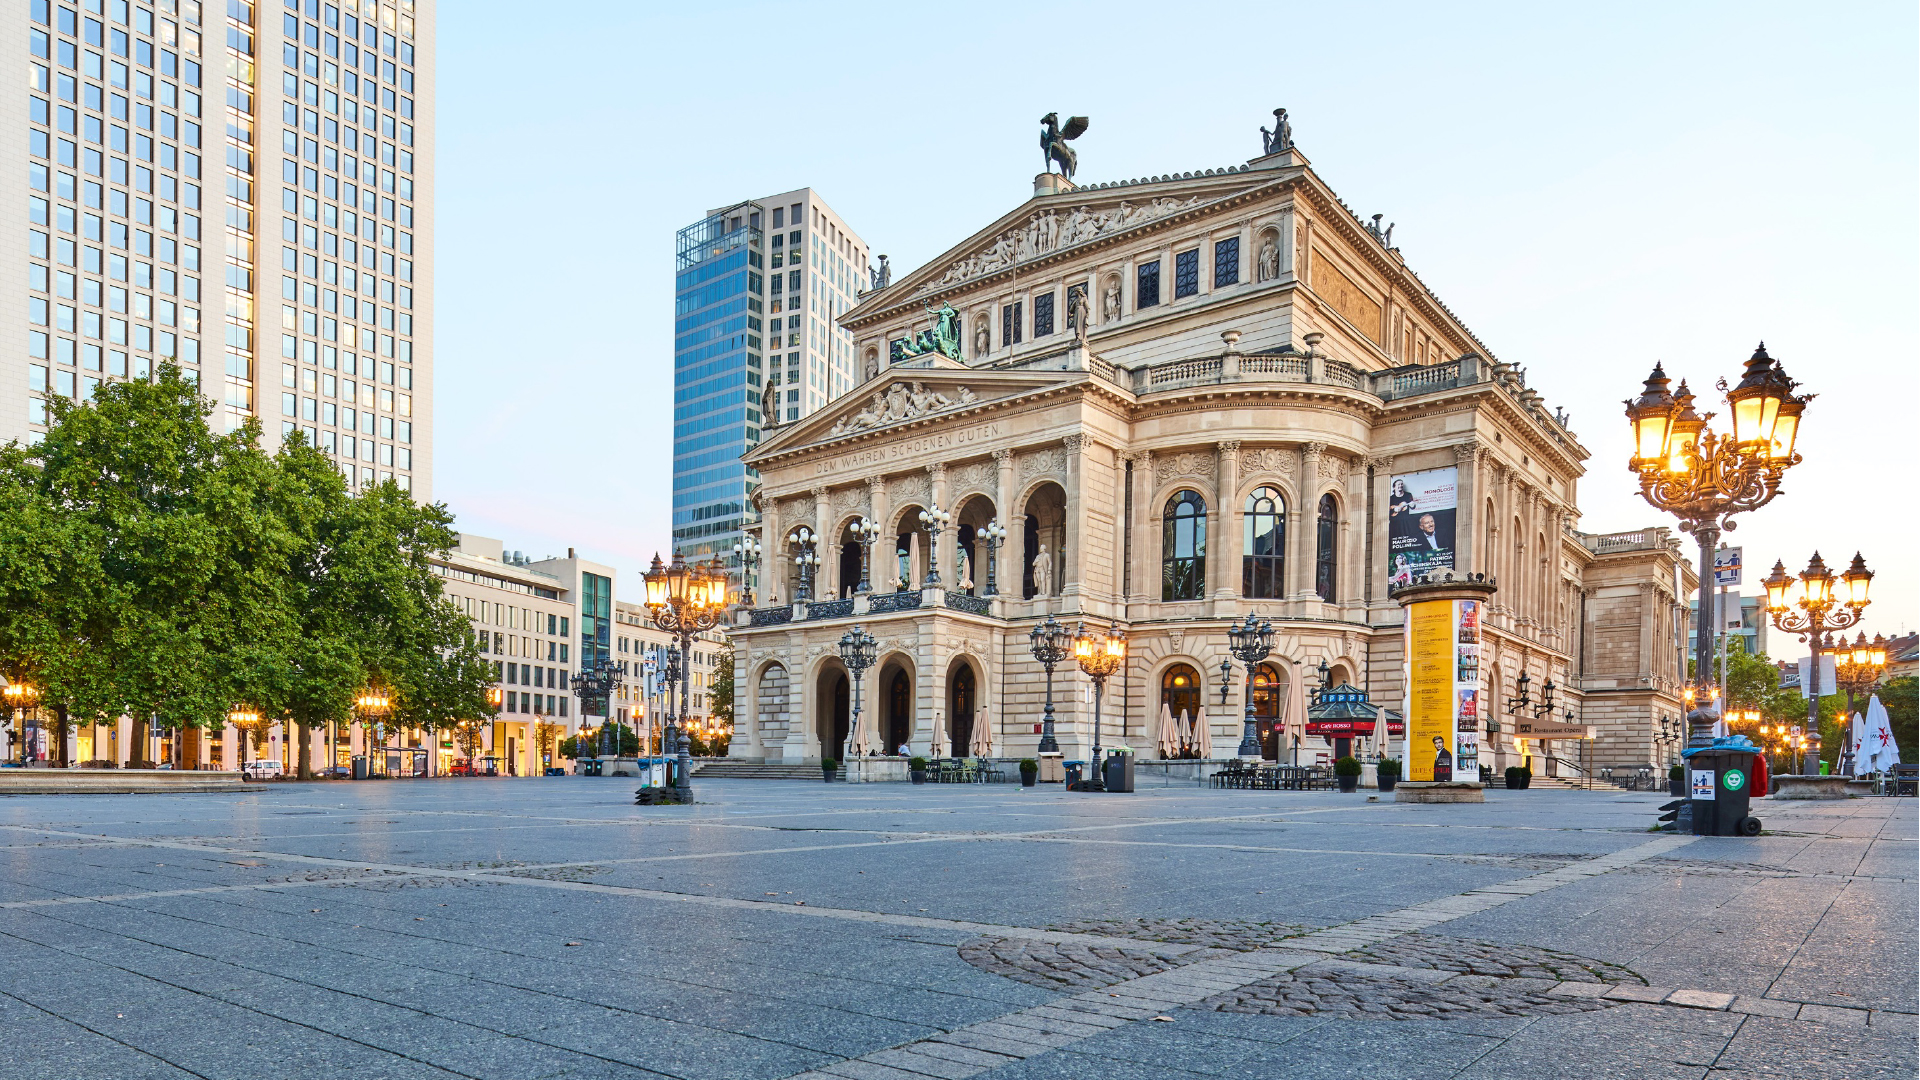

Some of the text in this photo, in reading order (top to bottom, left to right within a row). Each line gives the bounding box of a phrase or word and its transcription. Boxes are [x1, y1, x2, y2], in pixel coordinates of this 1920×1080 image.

[816, 424, 1003, 474] DEM WAHREN SCHOENEN GUTEN.
